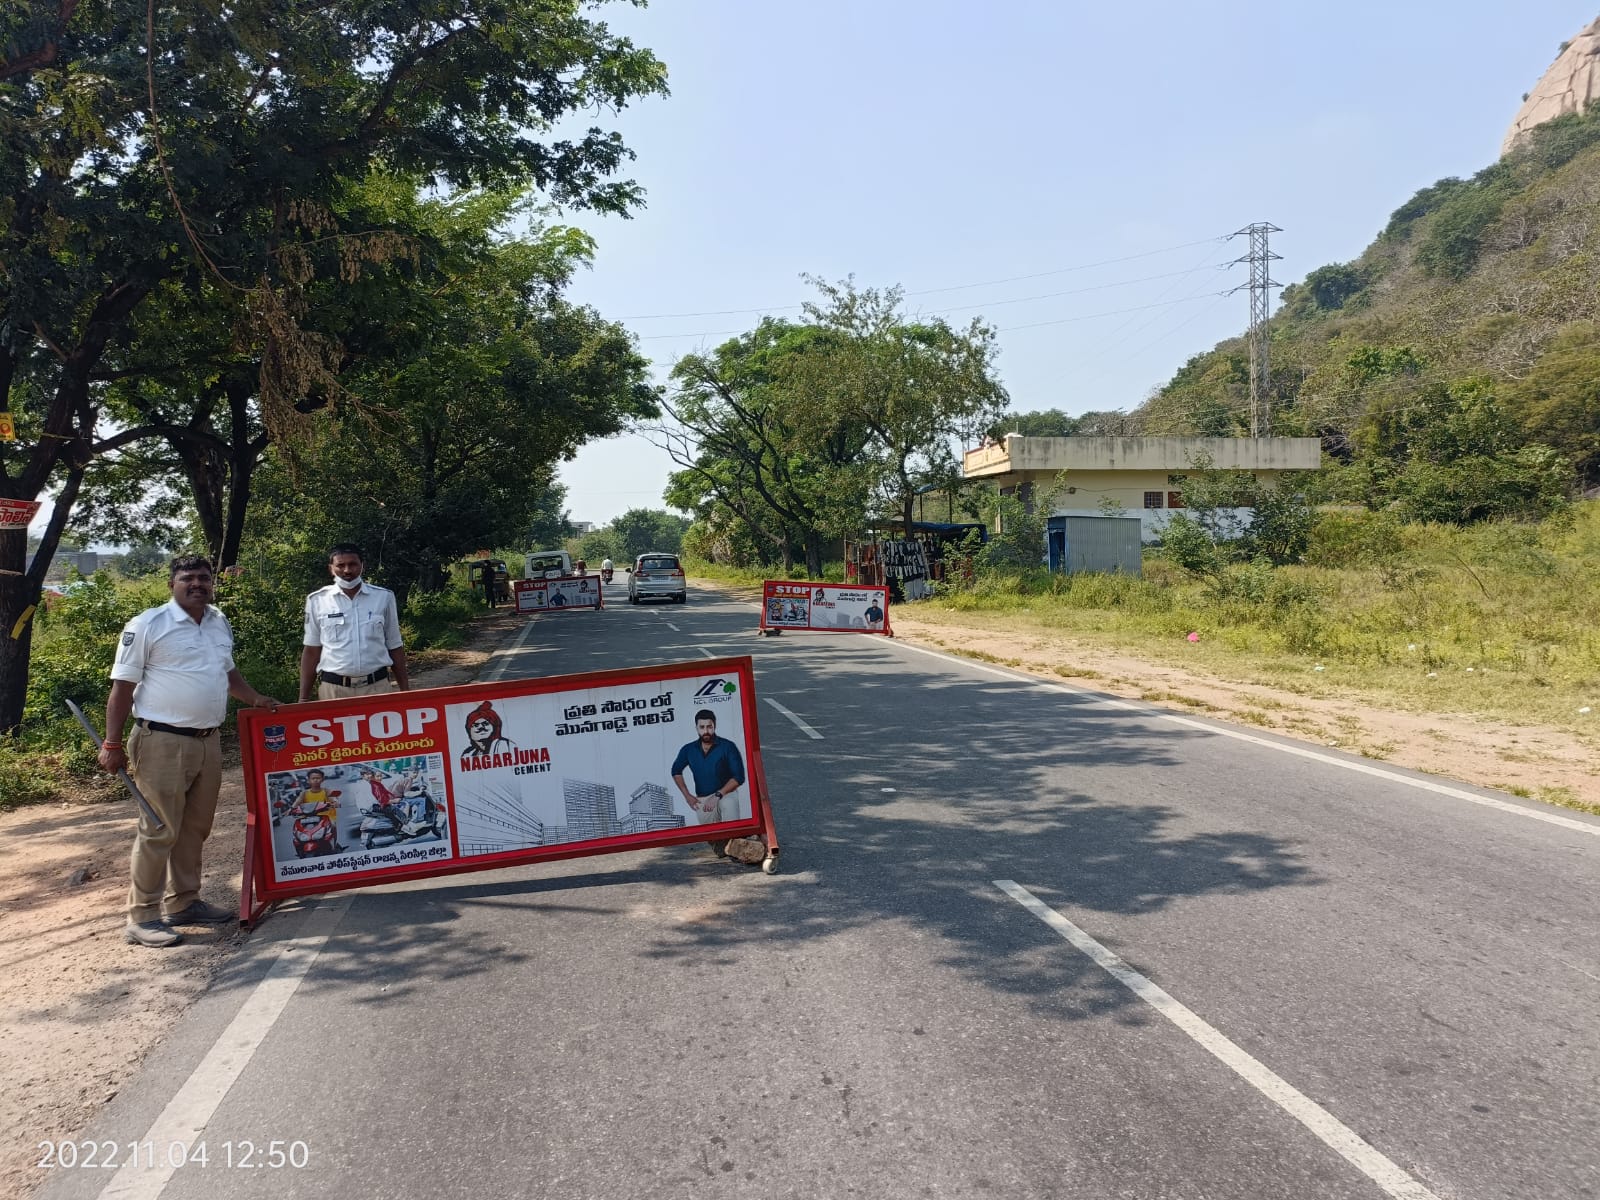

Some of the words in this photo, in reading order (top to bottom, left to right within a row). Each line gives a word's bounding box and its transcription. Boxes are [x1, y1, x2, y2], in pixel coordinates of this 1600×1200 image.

[776, 585, 810, 594] STOP
[563, 704, 597, 720] ప్రతి
[650, 691, 673, 707] లో
[632, 708, 675, 726] నిలిచే
[298, 708, 438, 747] STOP
[292, 747, 328, 766] మైనర్
[374, 737, 435, 753] చేయరాదు
[460, 747, 551, 772] NAGARJUNA
[514, 763, 551, 776] CEMENT
[280, 861, 325, 876] వేములవాడ
[372, 851, 400, 864] రాజన్న
